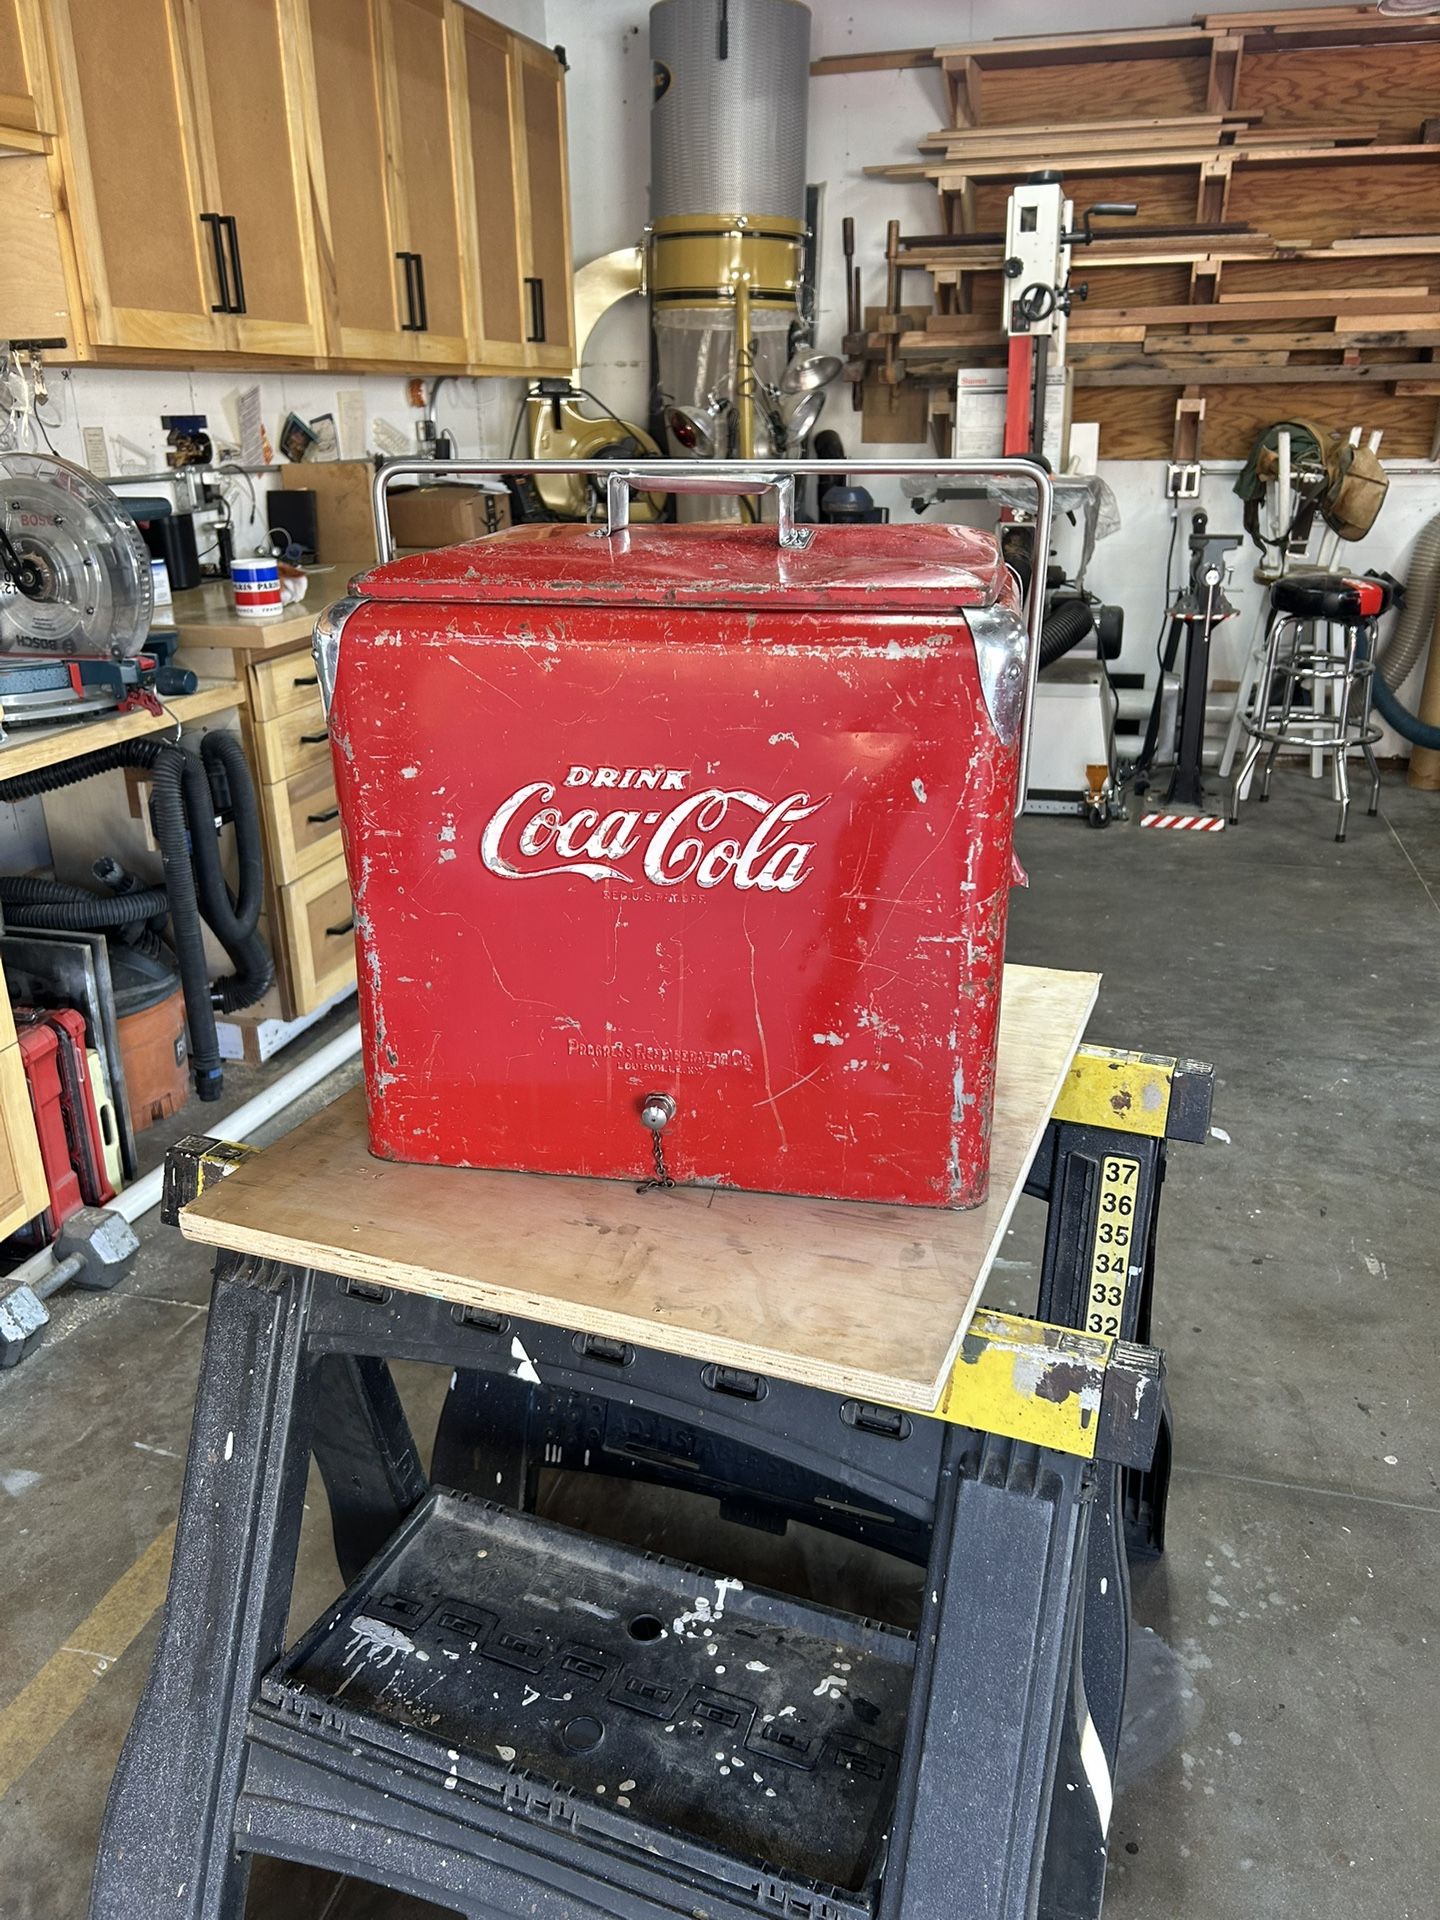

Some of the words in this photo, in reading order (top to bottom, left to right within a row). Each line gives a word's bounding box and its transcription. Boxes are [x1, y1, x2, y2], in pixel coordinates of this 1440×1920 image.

[564, 765, 690, 790] DRINK
[480, 780, 832, 893] Coca-Cola
[1106, 1162, 1137, 1184] 37
[1102, 1193, 1132, 1215] 36
[1099, 1223, 1129, 1246] 35
[1096, 1254, 1125, 1274] 34
[1092, 1283, 1122, 1307] 33
[1088, 1313, 1119, 1337] 32
